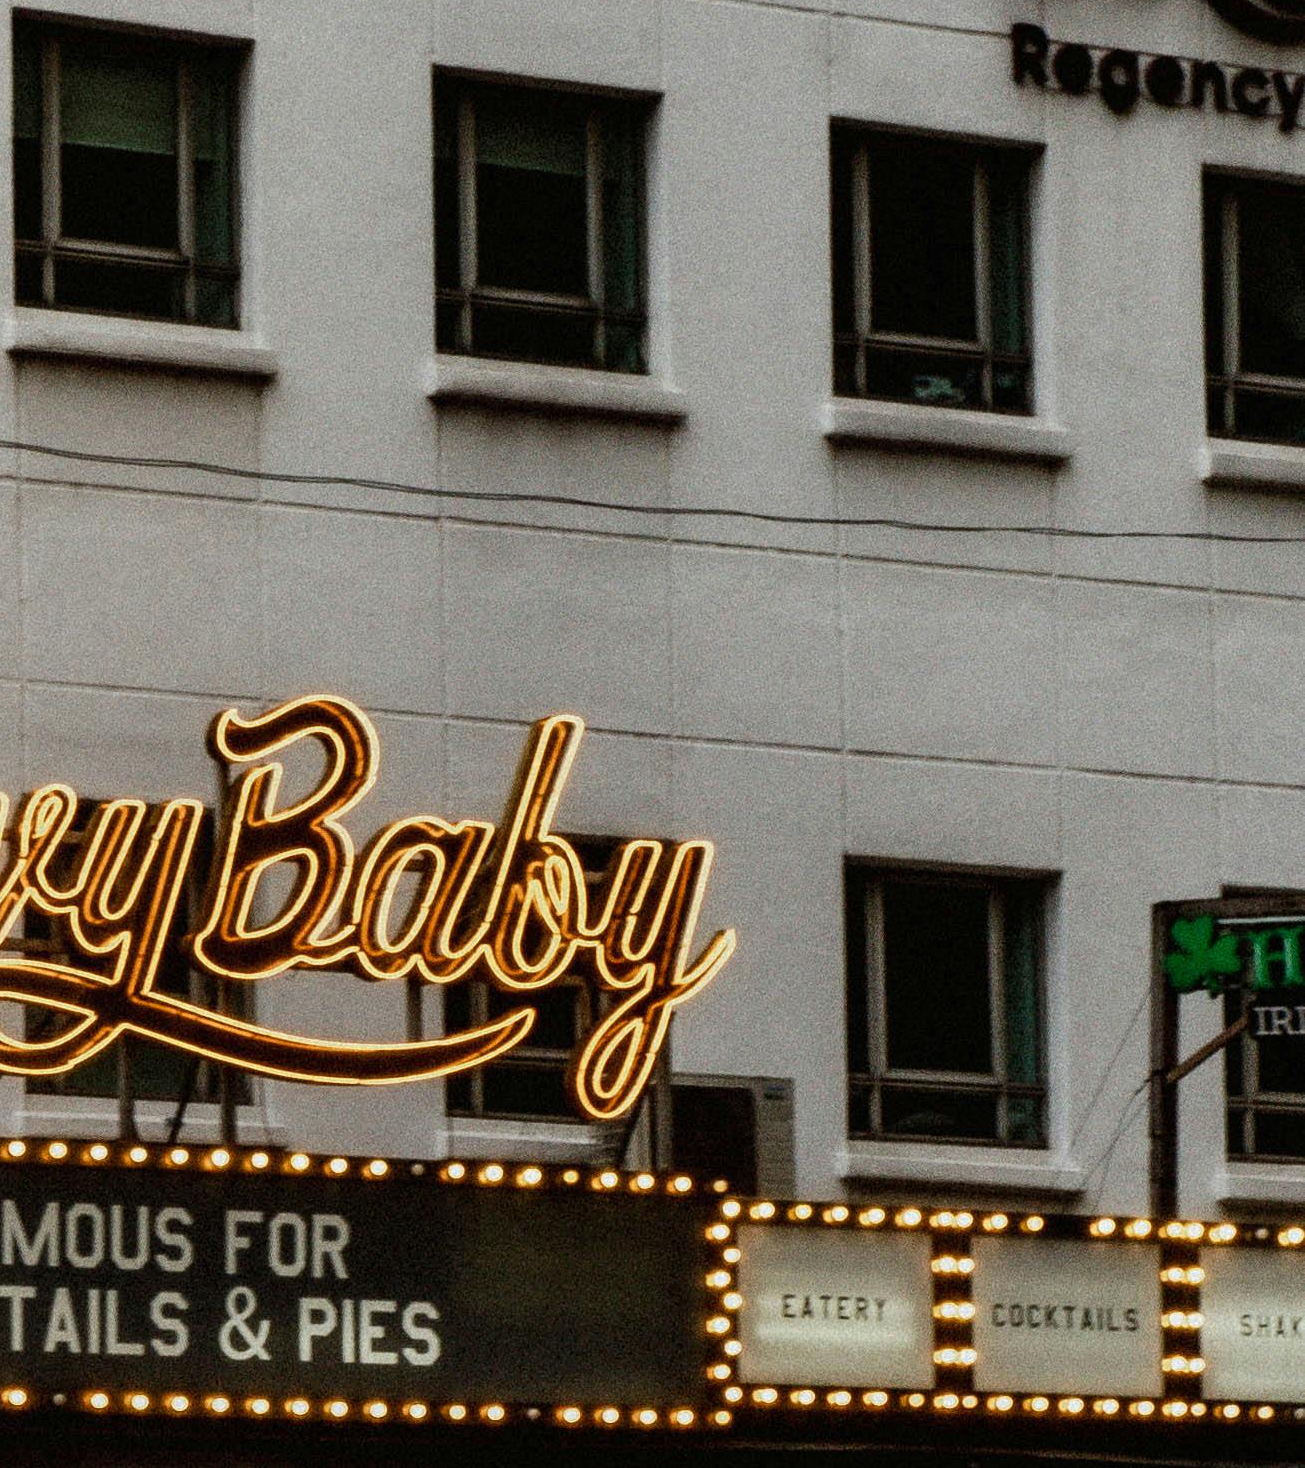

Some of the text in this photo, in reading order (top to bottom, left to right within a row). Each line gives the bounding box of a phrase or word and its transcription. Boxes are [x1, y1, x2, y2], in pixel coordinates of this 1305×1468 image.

[1010, 21, 1305, 134] Regency
[195, 692, 737, 1120] Baby
[223, 1209, 351, 1279] FOR
[218, 1285, 272, 1362] &
[297, 1296, 442, 1366] PIES
[781, 1293, 888, 1323] EATERY
[991, 1302, 1139, 1332] COCKTAILS
